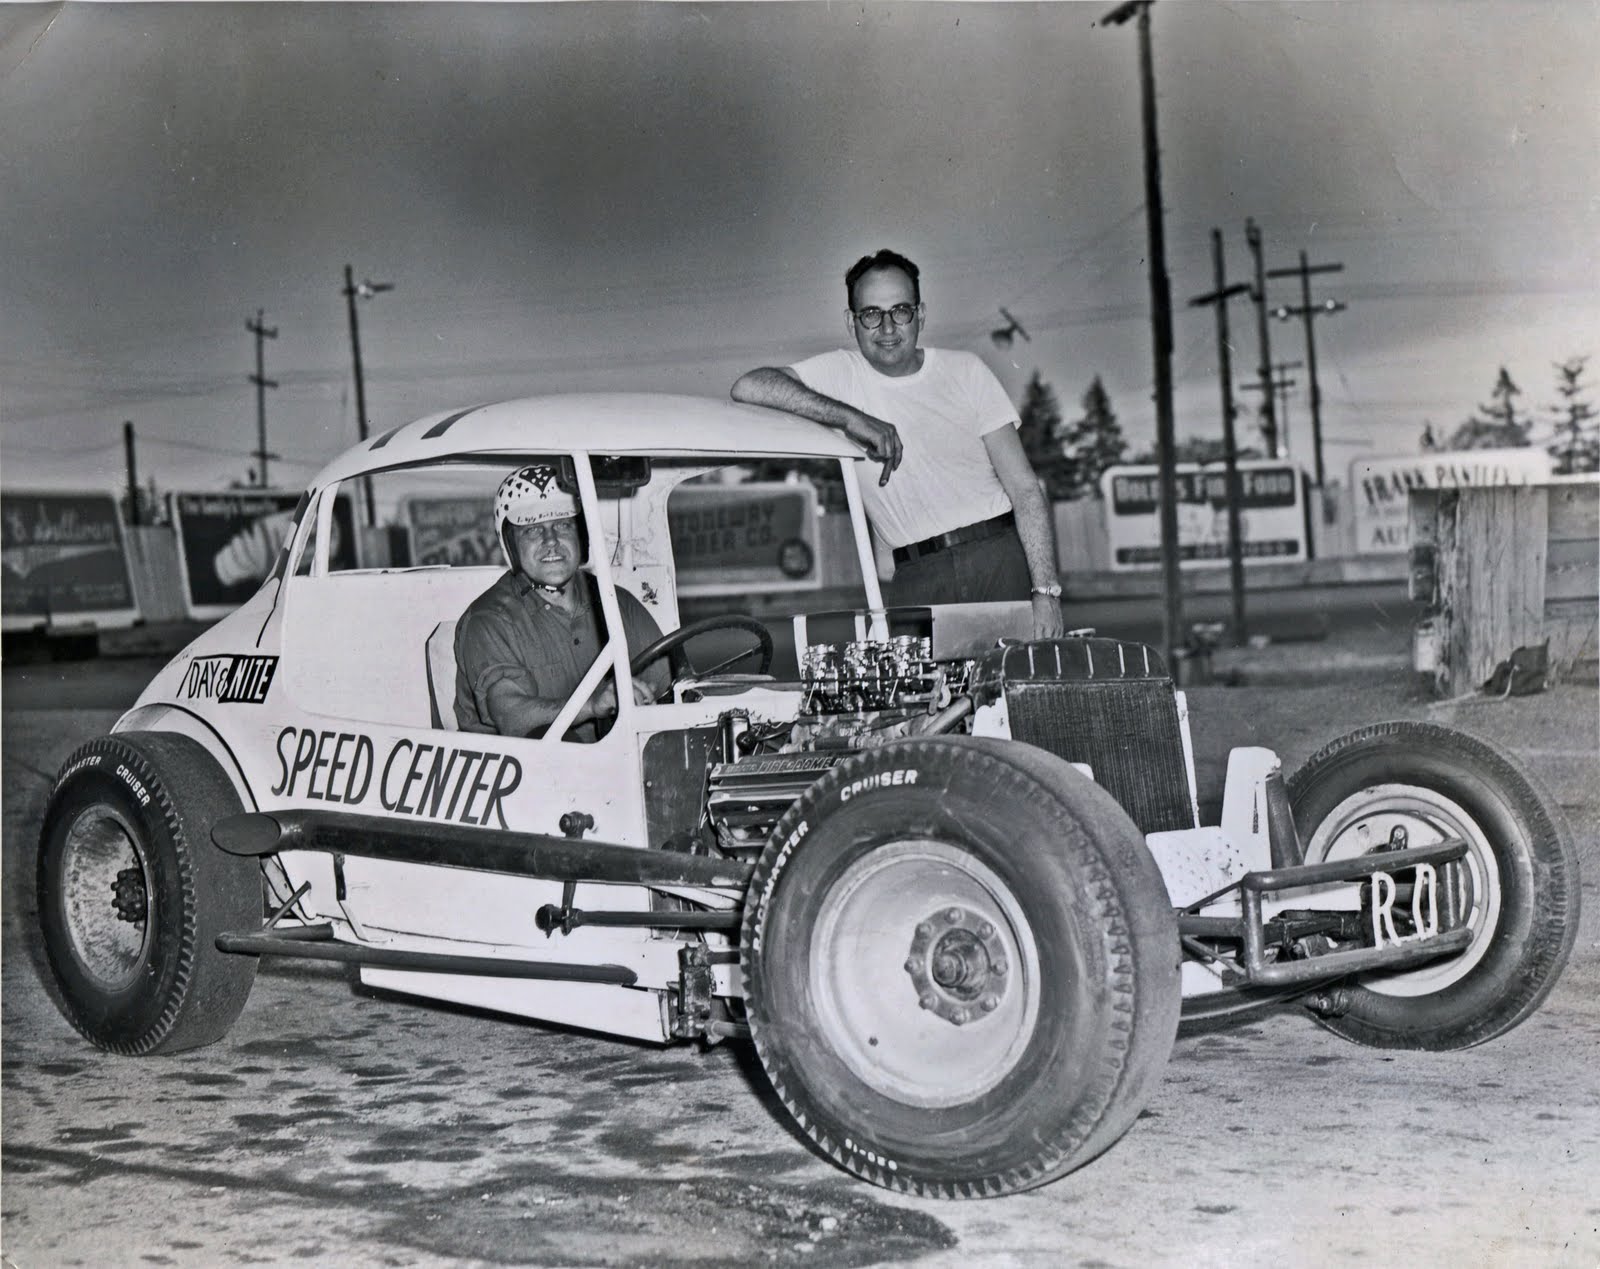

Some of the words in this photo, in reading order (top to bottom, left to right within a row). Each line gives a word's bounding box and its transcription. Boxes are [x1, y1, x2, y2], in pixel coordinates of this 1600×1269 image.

[188, 660, 222, 699] DAY
[226, 658, 275, 700] NITE
[115, 763, 151, 808] CRUISER
[271, 726, 375, 805] SPEED
[379, 738, 523, 830] CENTER
[840, 769, 919, 802] CRUISER
